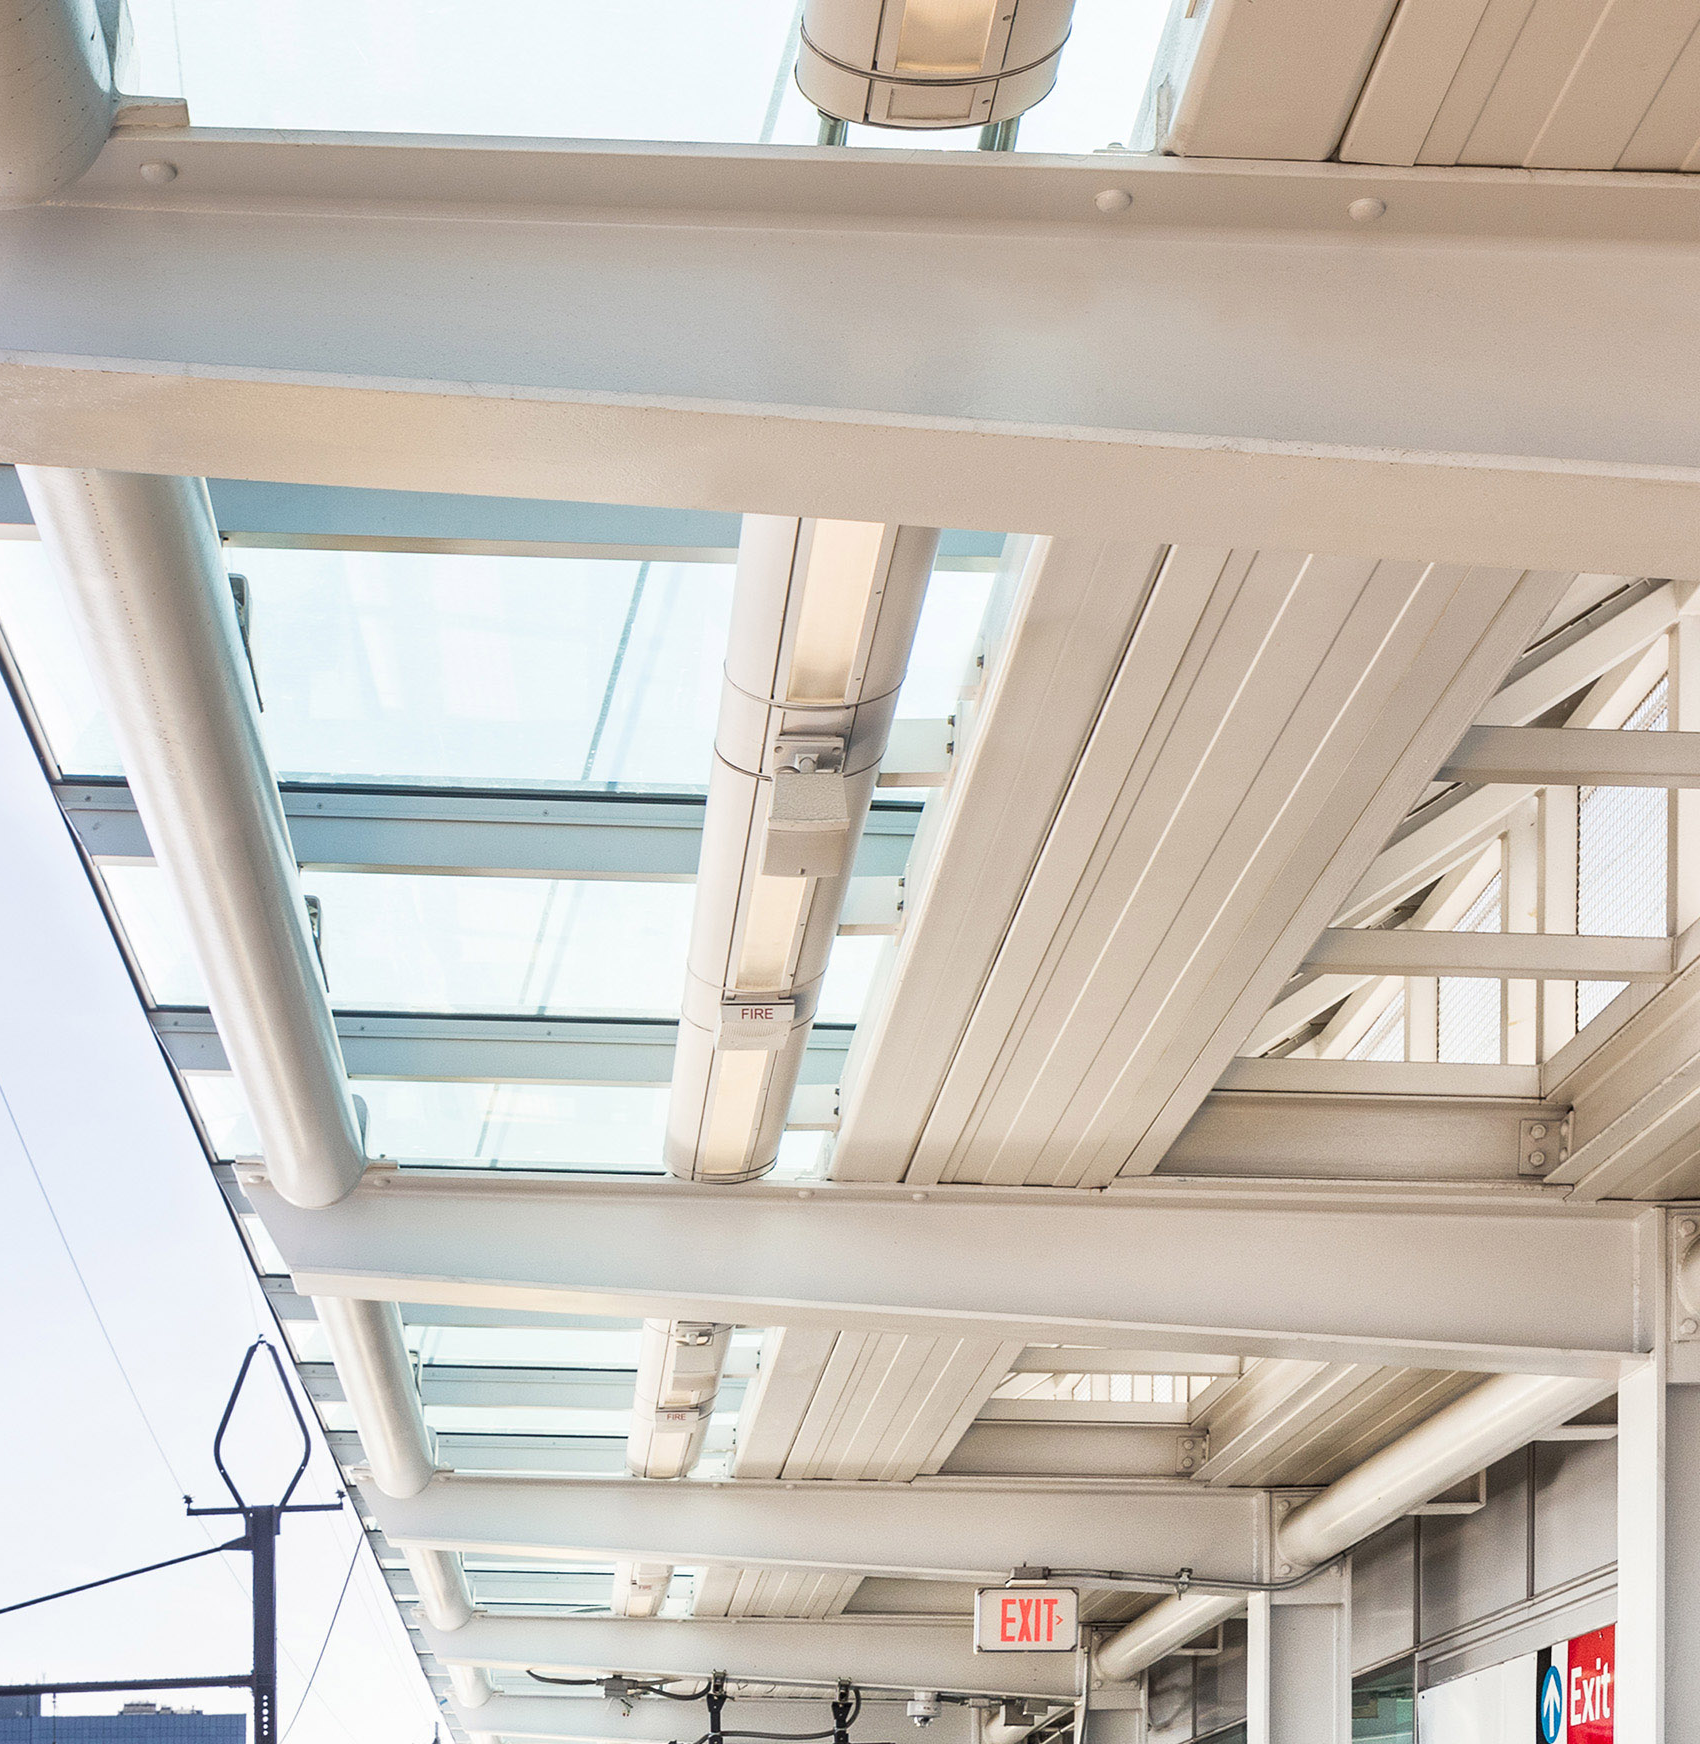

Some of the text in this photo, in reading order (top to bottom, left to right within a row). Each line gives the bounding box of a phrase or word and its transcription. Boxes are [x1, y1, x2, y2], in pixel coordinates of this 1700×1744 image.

[741, 1008, 774, 1020] FIRE
[666, 1413, 687, 1421] FIRE
[1000, 1598, 1059, 1642] EXIT
[1570, 1657, 1611, 1727] Exit
